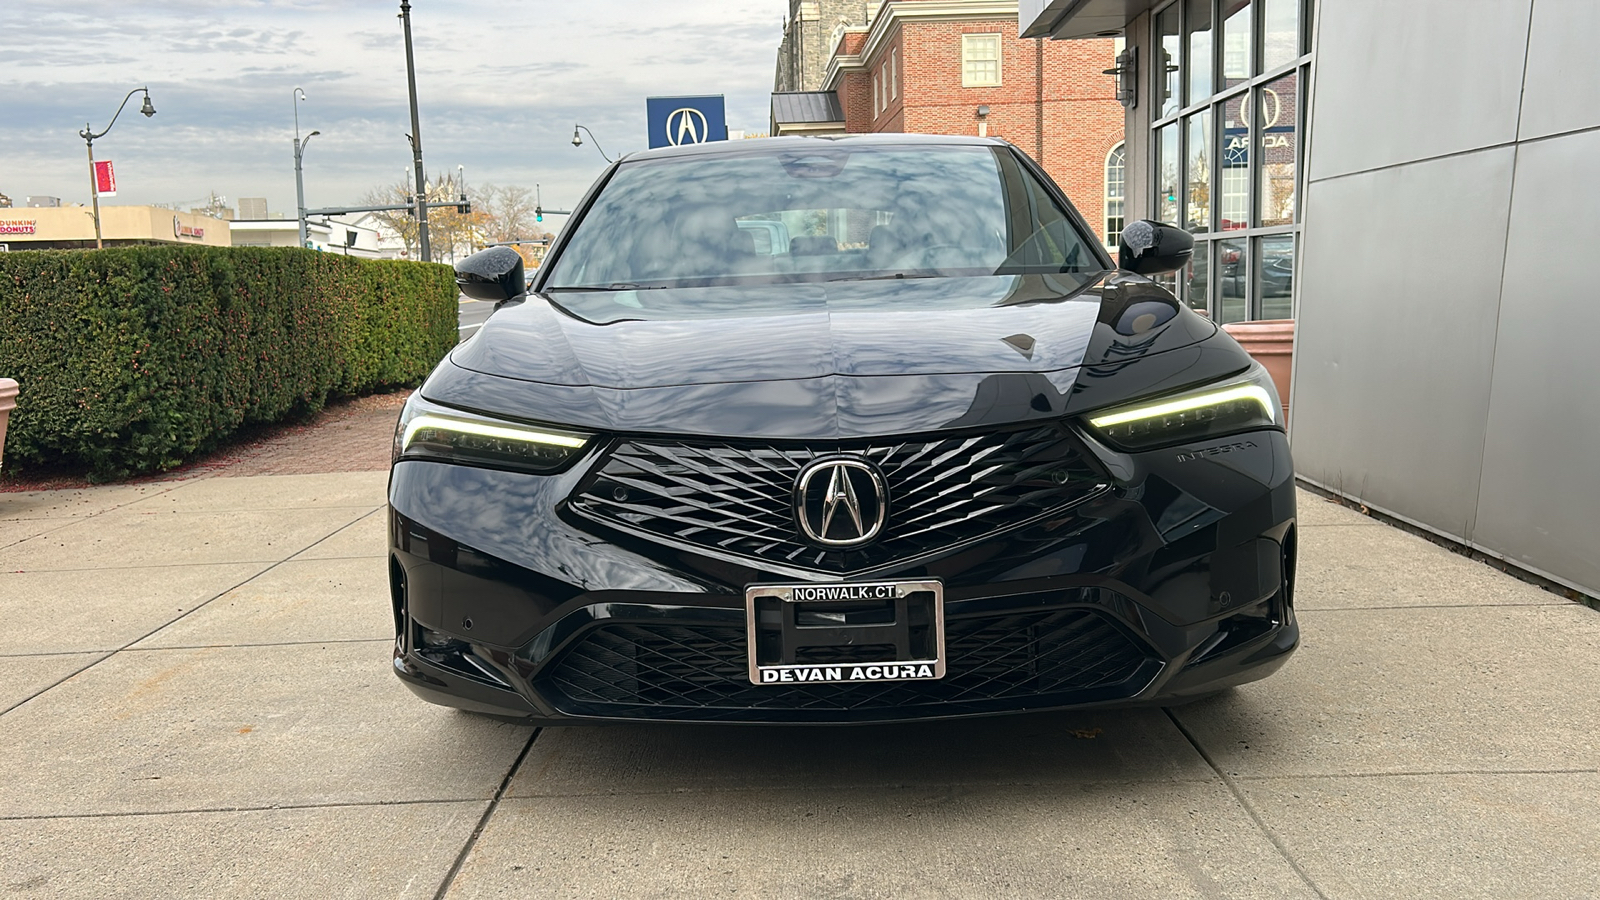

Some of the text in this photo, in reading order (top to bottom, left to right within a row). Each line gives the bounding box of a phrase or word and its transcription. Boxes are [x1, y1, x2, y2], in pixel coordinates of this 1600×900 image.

[1176, 441, 1258, 462] INTEGRA
[875, 585, 895, 598] CT
[763, 664, 933, 683] DEVAN ACURA
